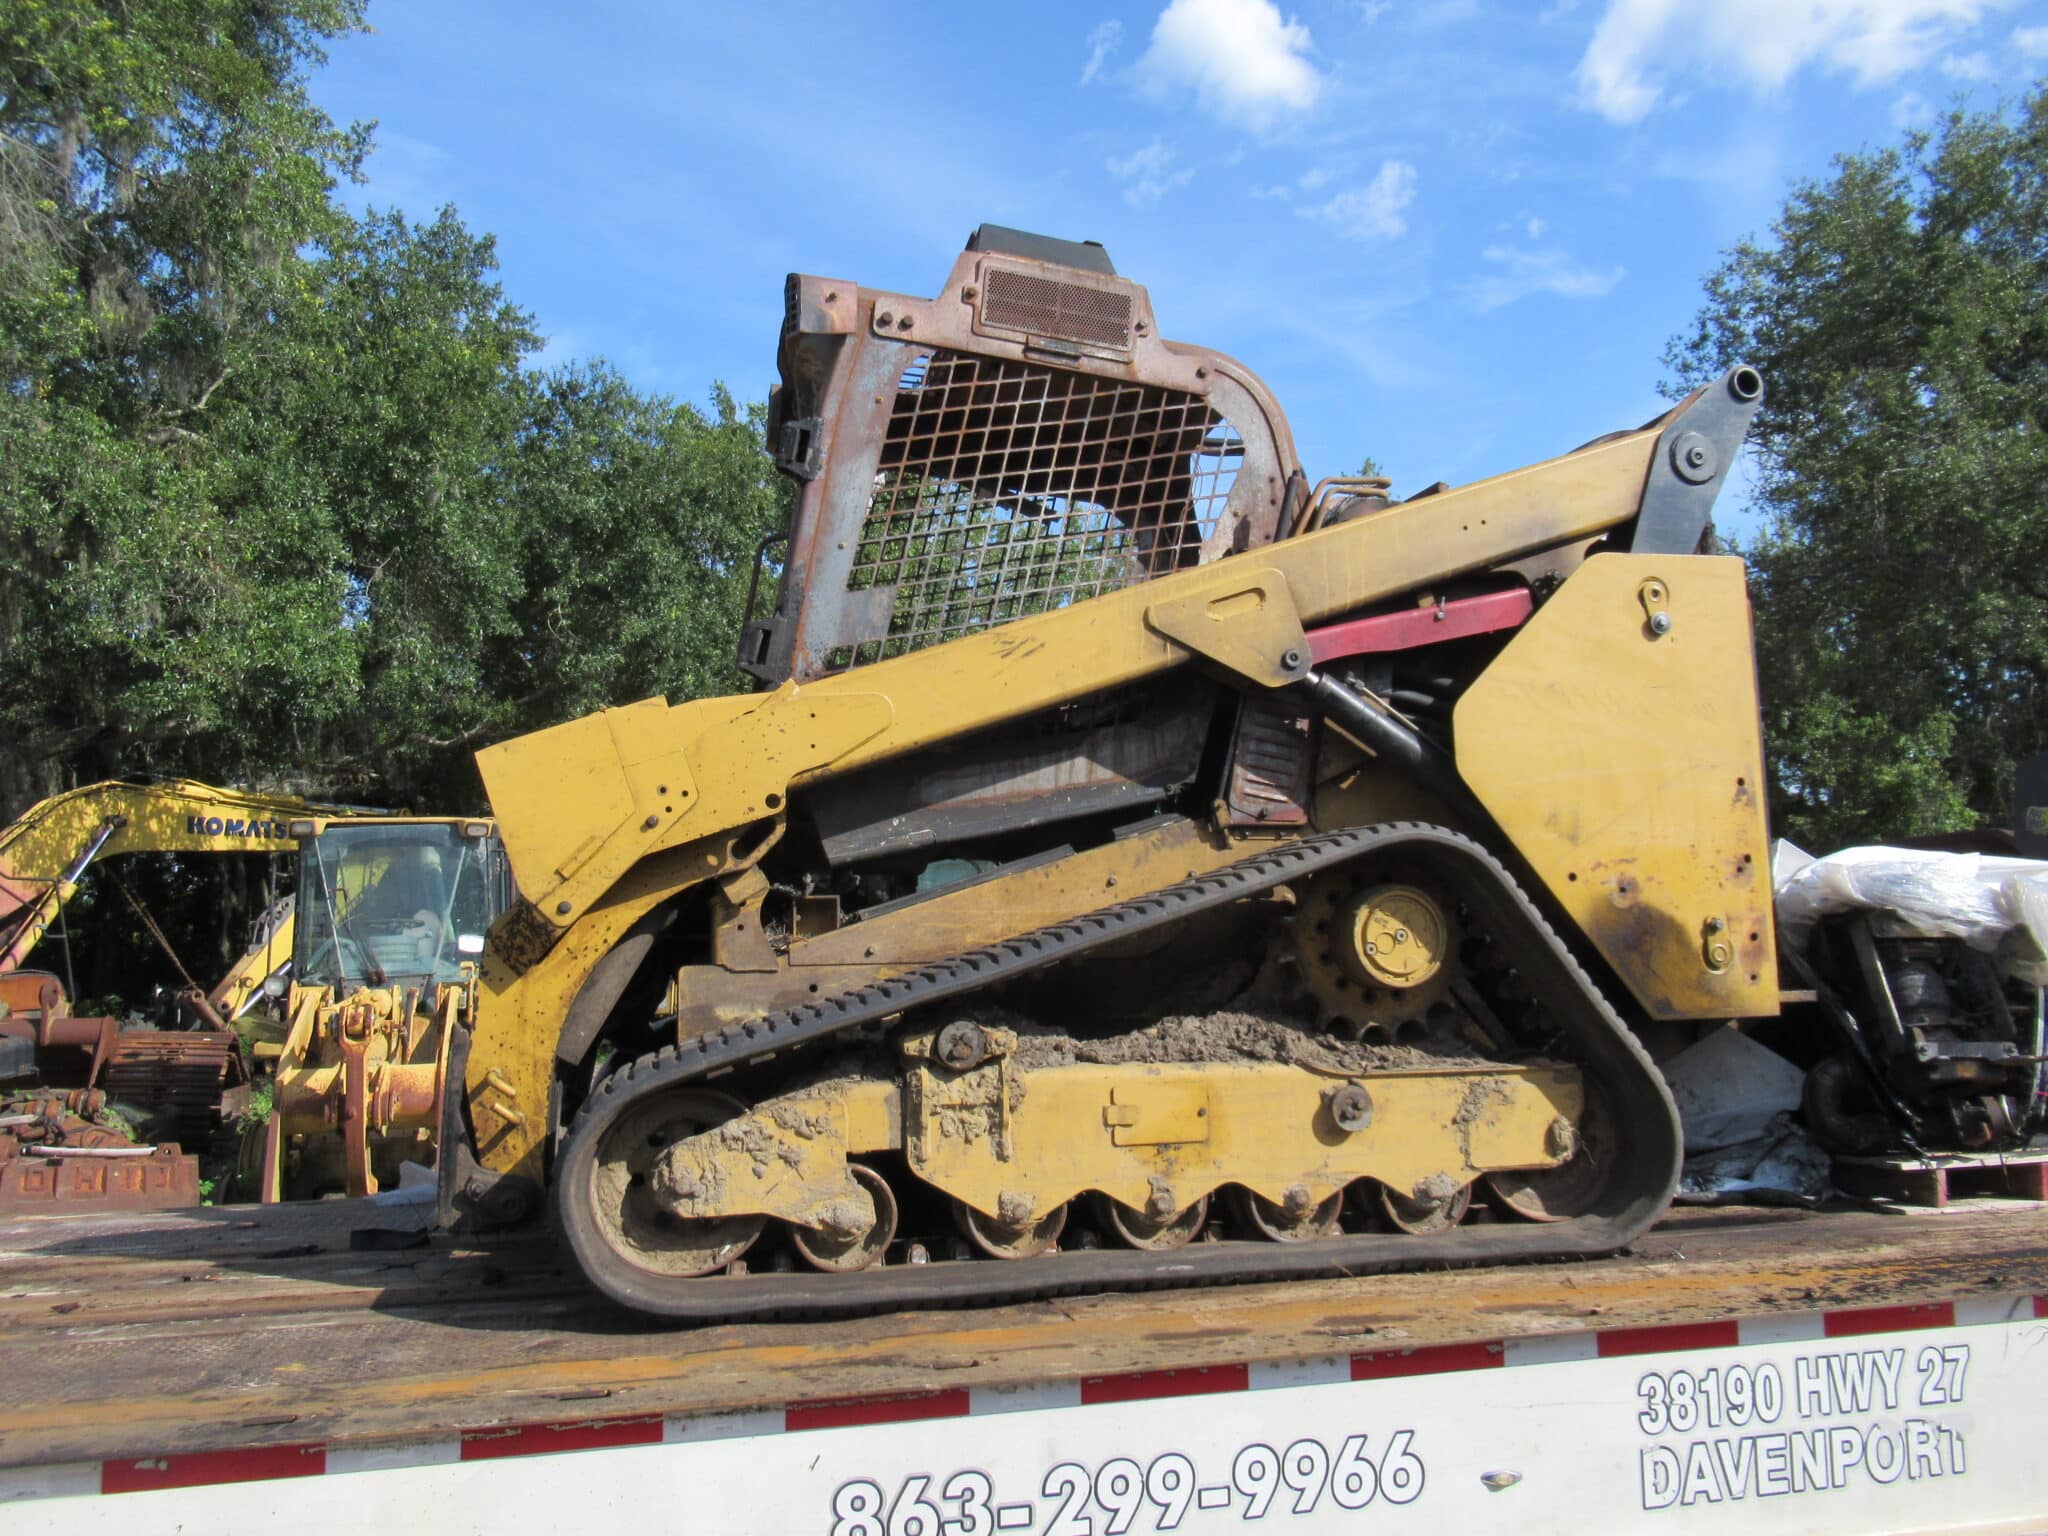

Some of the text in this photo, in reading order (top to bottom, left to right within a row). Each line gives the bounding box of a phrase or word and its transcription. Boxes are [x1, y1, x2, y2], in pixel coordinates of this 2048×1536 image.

[187, 815, 289, 839] KOMATS
[1637, 1344, 1970, 1436] 38190 HWY 27
[830, 1429, 1426, 1536] 863-299-9966
[1640, 1418, 1967, 1511] DAVENPORT
